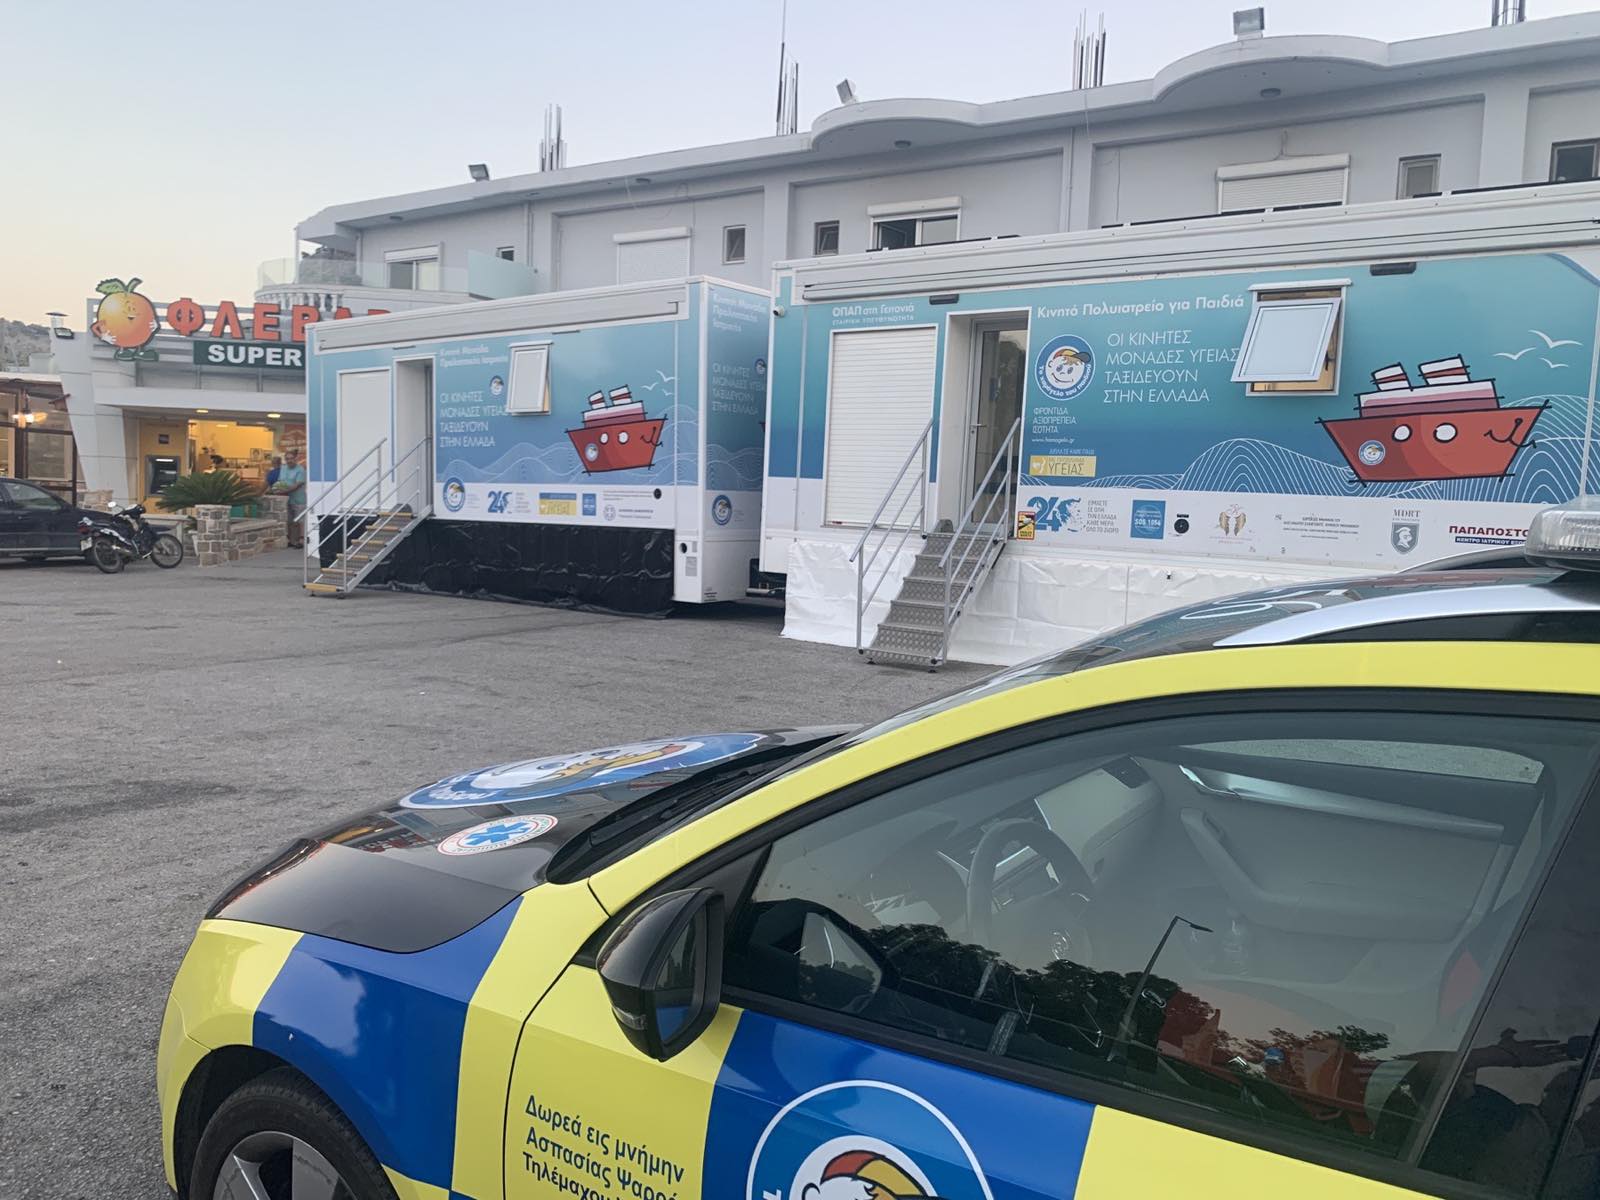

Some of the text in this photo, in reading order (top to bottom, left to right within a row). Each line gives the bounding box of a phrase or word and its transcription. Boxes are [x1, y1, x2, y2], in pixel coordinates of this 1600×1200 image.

[832, 306, 862, 317] ΟΠΑΠ
[1037, 294, 1244, 318] Κινητό Πολυιατρείο για Παιδιά
[1108, 330, 1192, 347] ΟΙ ΚΙΝΗΤΕΣ
[208, 344, 302, 367] SUPER
[1106, 350, 1184, 365] ΜΟΝΑΔΕΣ
[1104, 369, 1198, 384] ΤΑΞΙΔΕΥΟΥΝ
[1104, 388, 1209, 403] ΣΤΗΝ ΕΛΛΑΔΑ
[1048, 462, 1084, 475] ΥΓΕΙΑΣ
[525, 1094, 685, 1185] Δωρεά εις μνήμην
[526, 1126, 611, 1188] Ασπασίας
